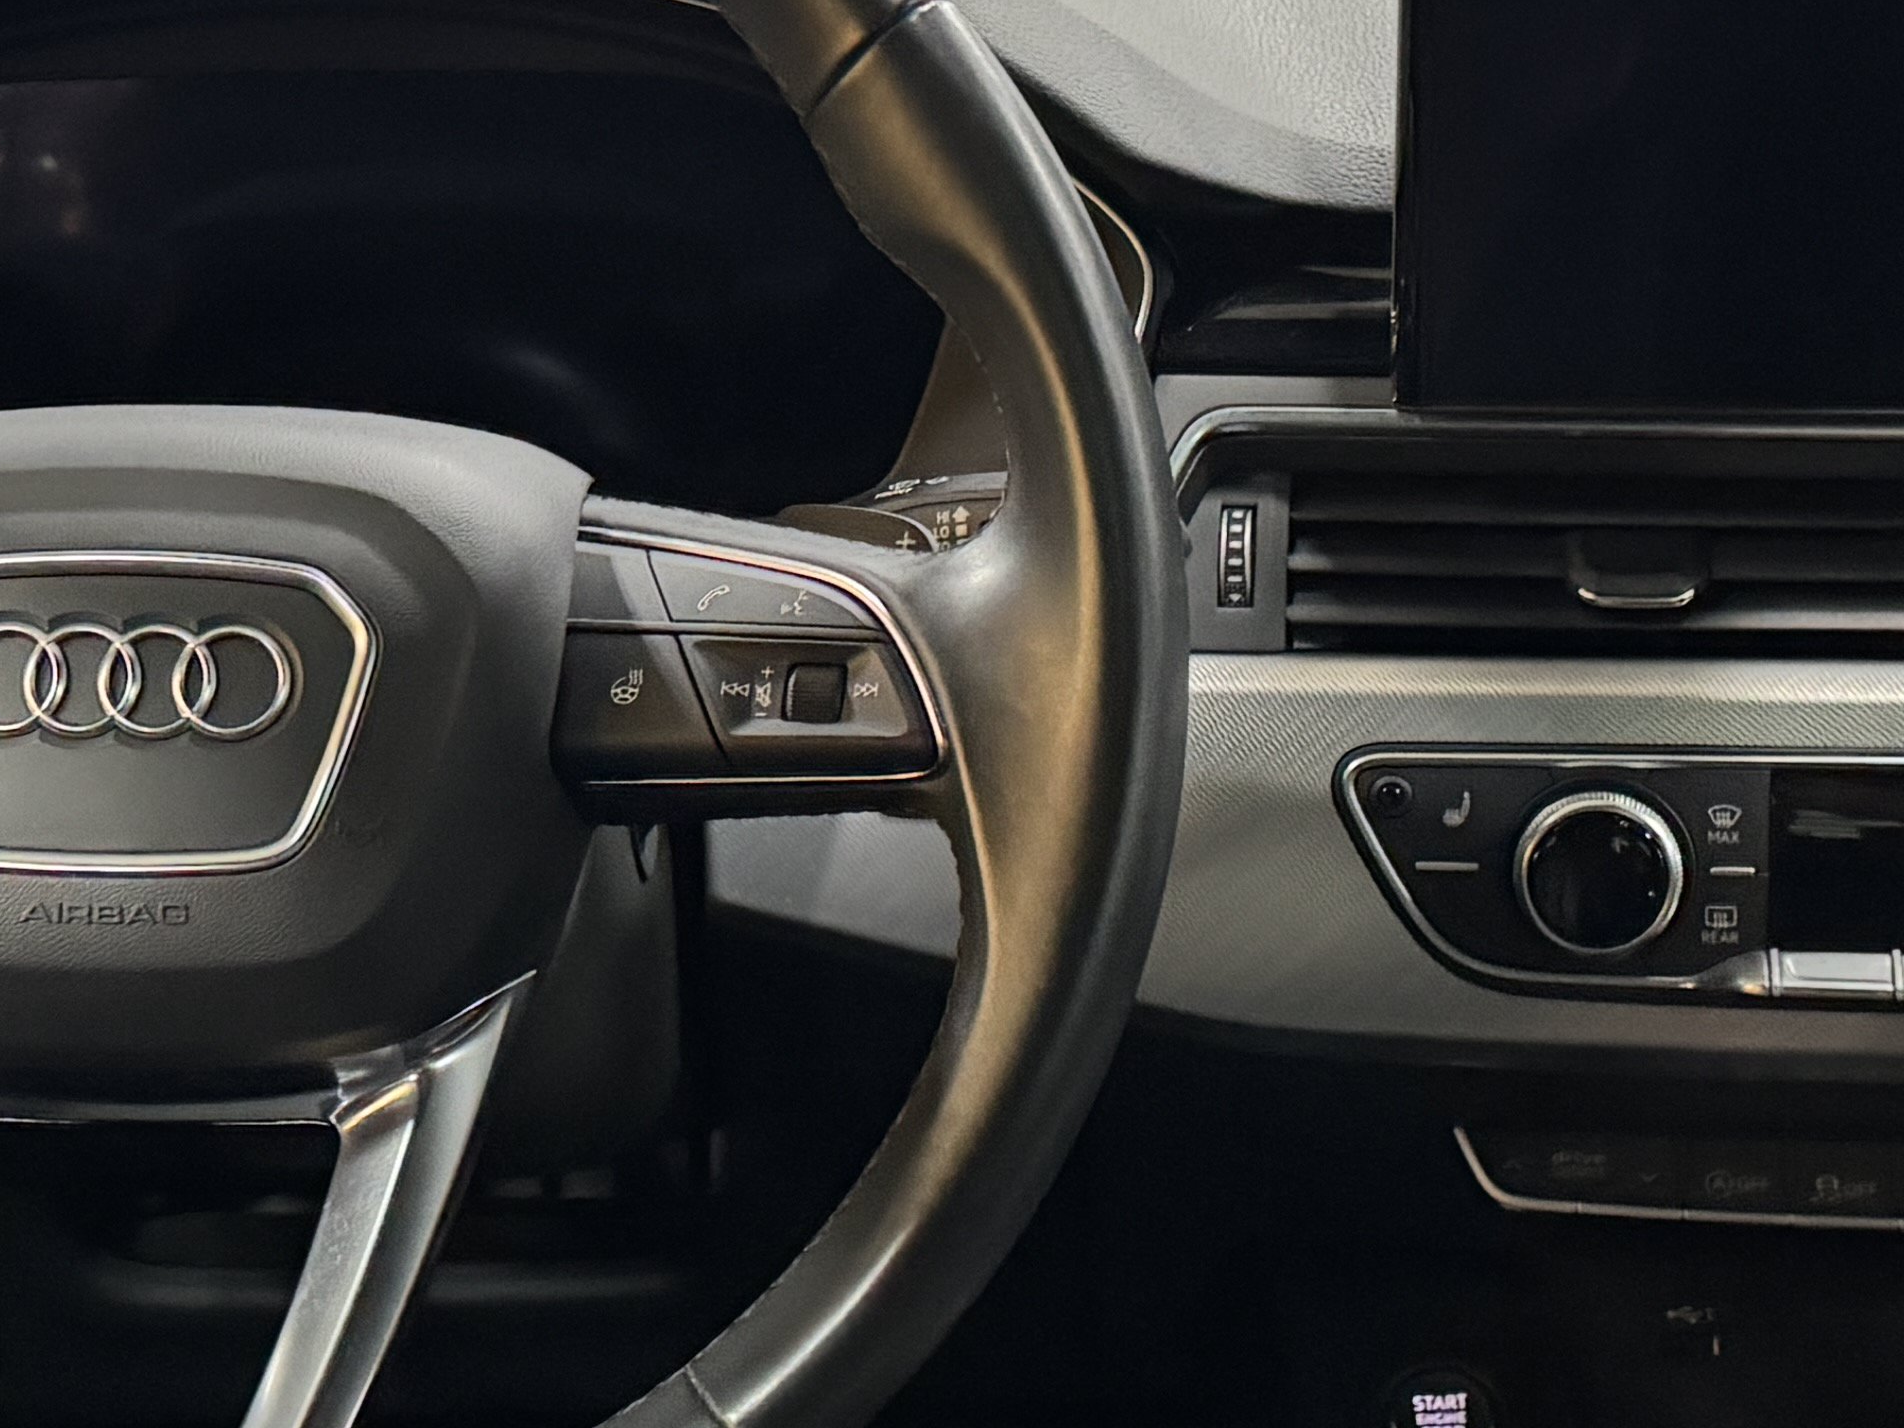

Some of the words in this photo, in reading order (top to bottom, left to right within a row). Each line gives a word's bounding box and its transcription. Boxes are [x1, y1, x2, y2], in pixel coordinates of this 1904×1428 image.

[937, 511, 951, 524] HI
[933, 526, 949, 539] LO
[1707, 830, 1740, 845] MAX
[16, 901, 190, 926] AIRBAG
[1701, 930, 1739, 945] REAR
[1412, 1392, 1467, 1412] START
